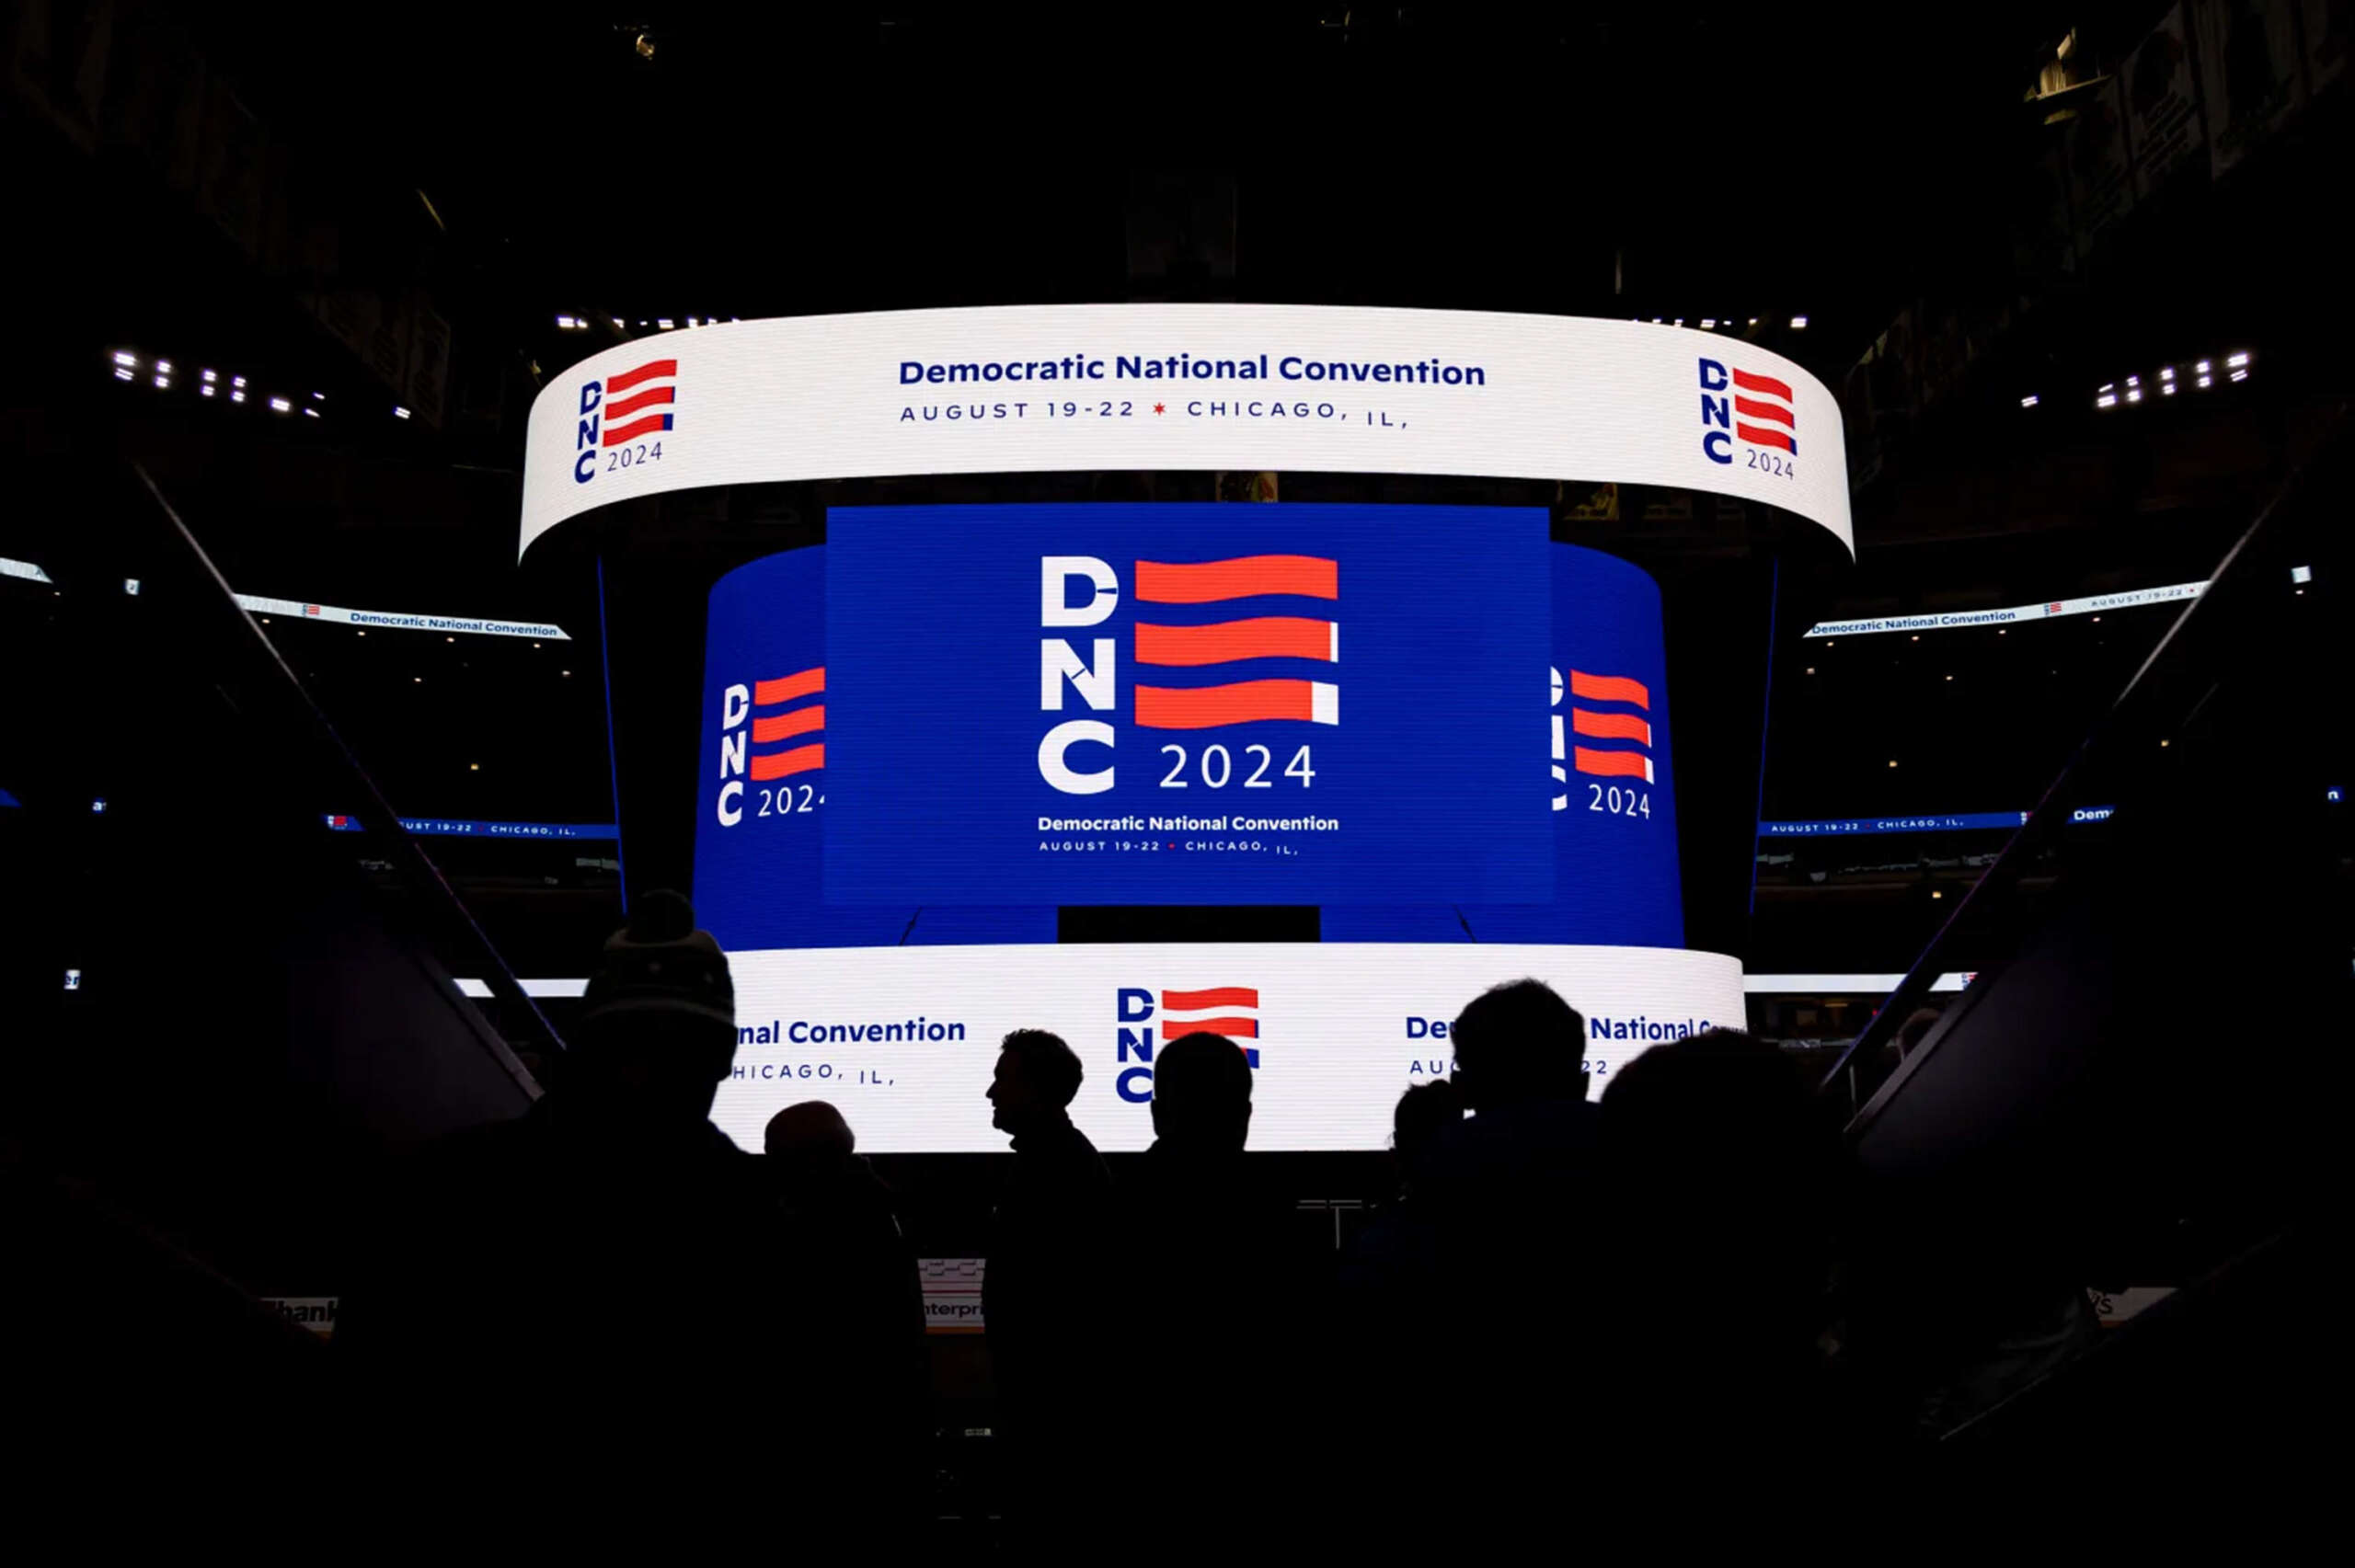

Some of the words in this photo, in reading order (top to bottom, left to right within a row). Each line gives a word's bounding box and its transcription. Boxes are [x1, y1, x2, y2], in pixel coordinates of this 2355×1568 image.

[900, 355, 1106, 384] Democratic
[1116, 354, 1269, 380] National
[1279, 355, 1486, 386] Convention
[901, 403, 1028, 421] AUGUST
[1048, 402, 1134, 418] 19-22
[1187, 402, 1349, 421] CHICAGO,
[1367, 411, 1409, 429] IL,
[1698, 357, 1733, 464] DNC
[575, 380, 602, 484] DNC
[607, 442, 662, 472] 2024
[1746, 448, 1794, 481] 2024
[2091, 594, 2140, 607] AUGUST
[350, 612, 425, 626] Democratic
[429, 619, 482, 630] National
[485, 623, 557, 636] Convention
[1812, 620, 1882, 635] Democratic
[1885, 616, 1938, 628] National
[1941, 607, 2016, 624] Convention
[1038, 555, 1119, 795] DNC
[717, 683, 750, 828] DNC
[1160, 744, 1315, 788] 2024
[757, 784, 825, 818] 202
[1589, 784, 1650, 820] 2024
[1038, 817, 1144, 830] Democratic
[1150, 816, 1226, 830] National
[1232, 816, 1339, 830] Convention
[1771, 824, 1818, 832] AUGUST
[1039, 841, 1107, 851] AUGUST
[1115, 841, 1160, 851] 19-22
[1185, 841, 1268, 852] CHICAGO,
[788, 1017, 966, 1045] Convention
[1591, 1016, 1694, 1040] National
[1116, 988, 1155, 1104] DNC
[733, 1064, 843, 1081] HICAGO,
[860, 1070, 895, 1086] IL,
